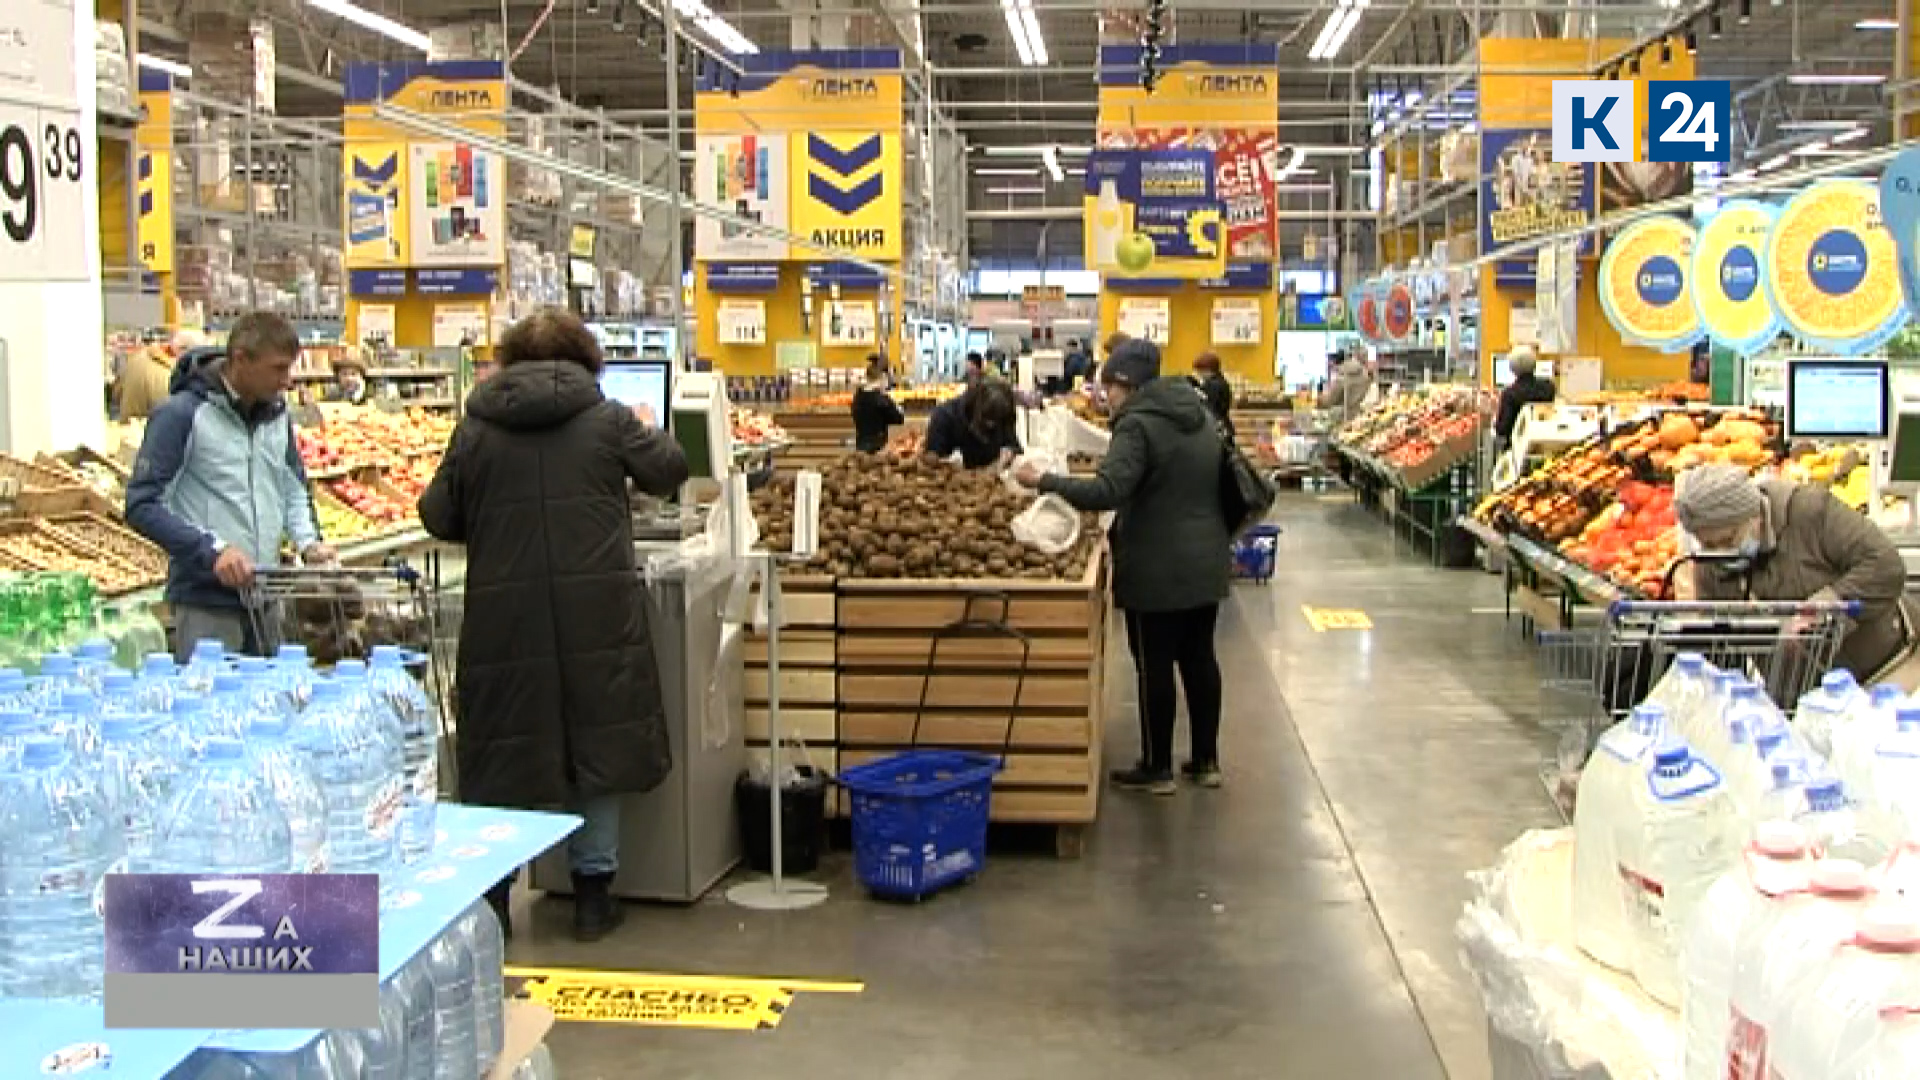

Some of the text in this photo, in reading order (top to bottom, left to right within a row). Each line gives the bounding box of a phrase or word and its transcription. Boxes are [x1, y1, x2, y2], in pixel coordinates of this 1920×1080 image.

[813, 78, 878, 98] ЛЕНТА
[1199, 74, 1267, 93] ЛЕНТА
[430, 90, 492, 108] ЛЕНТА
[44, 123, 82, 182] 39
[811, 229, 884, 248] АКЦИЯ
